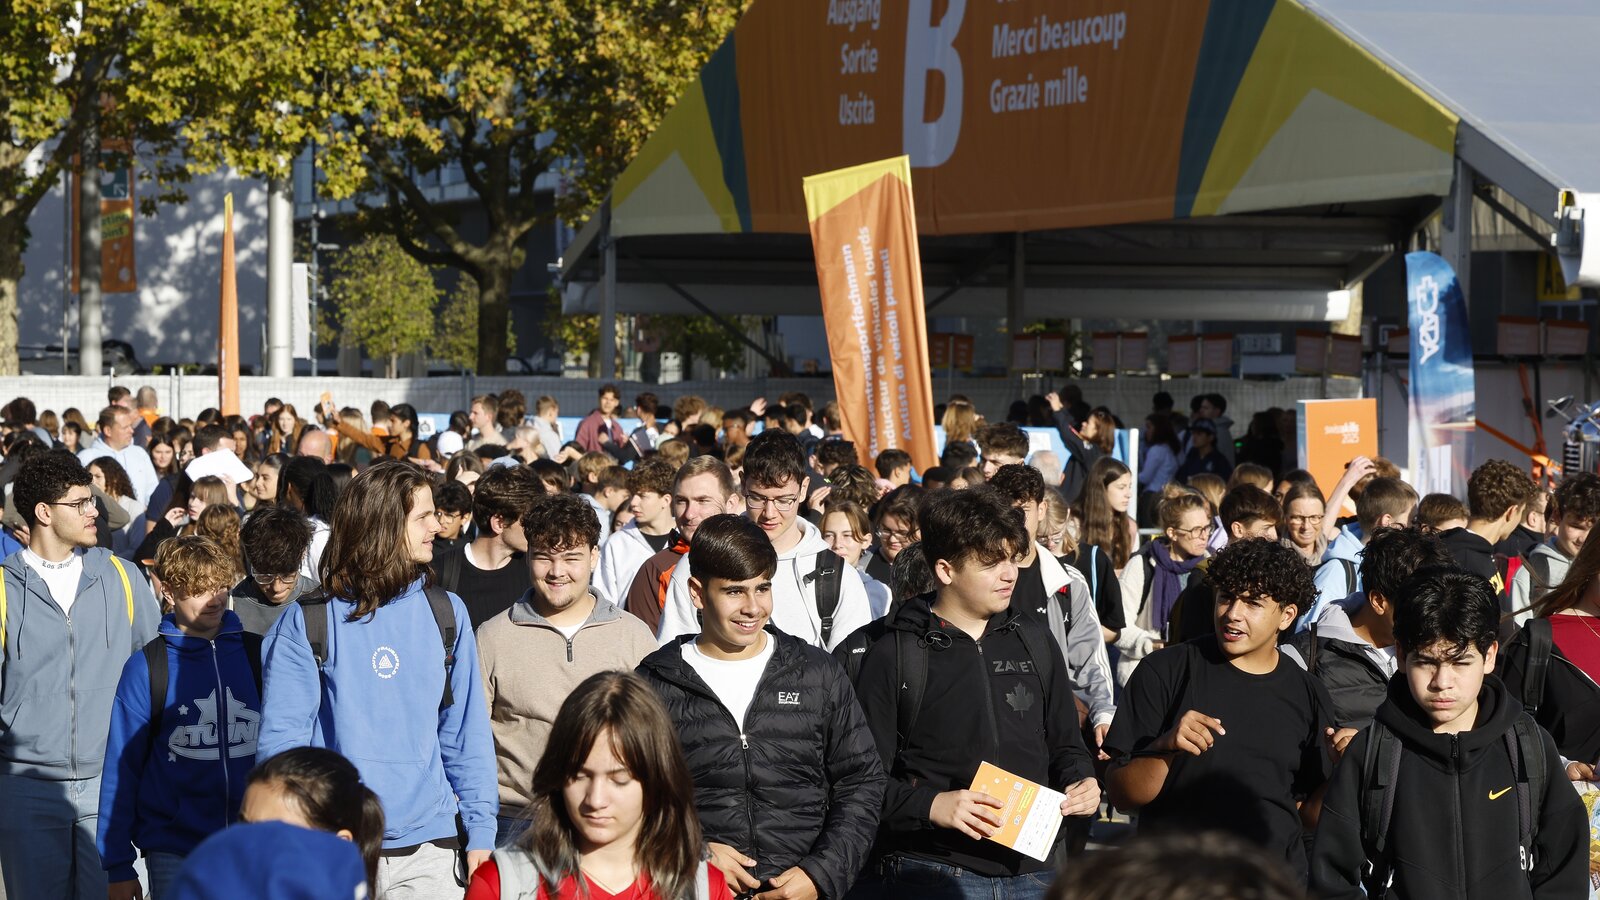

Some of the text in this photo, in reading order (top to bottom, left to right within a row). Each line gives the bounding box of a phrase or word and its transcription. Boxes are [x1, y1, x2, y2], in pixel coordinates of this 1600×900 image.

[827, 0, 880, 31] Ausgang
[992, 11, 1127, 59] Merci beaucoup
[841, 41, 877, 74] Sortie
[903, 0, 966, 168] B
[990, 66, 1088, 113] Grazie mille
[839, 92, 874, 124] Uscita
[858, 226, 875, 276] lourds
[842, 243, 879, 458] Strassentransportfachmann
[877, 355, 885, 375] de
[879, 248, 912, 440] Autista di veicoli pesanti
[879, 380, 897, 450] nducteur
[778, 691, 800, 701] EA7
